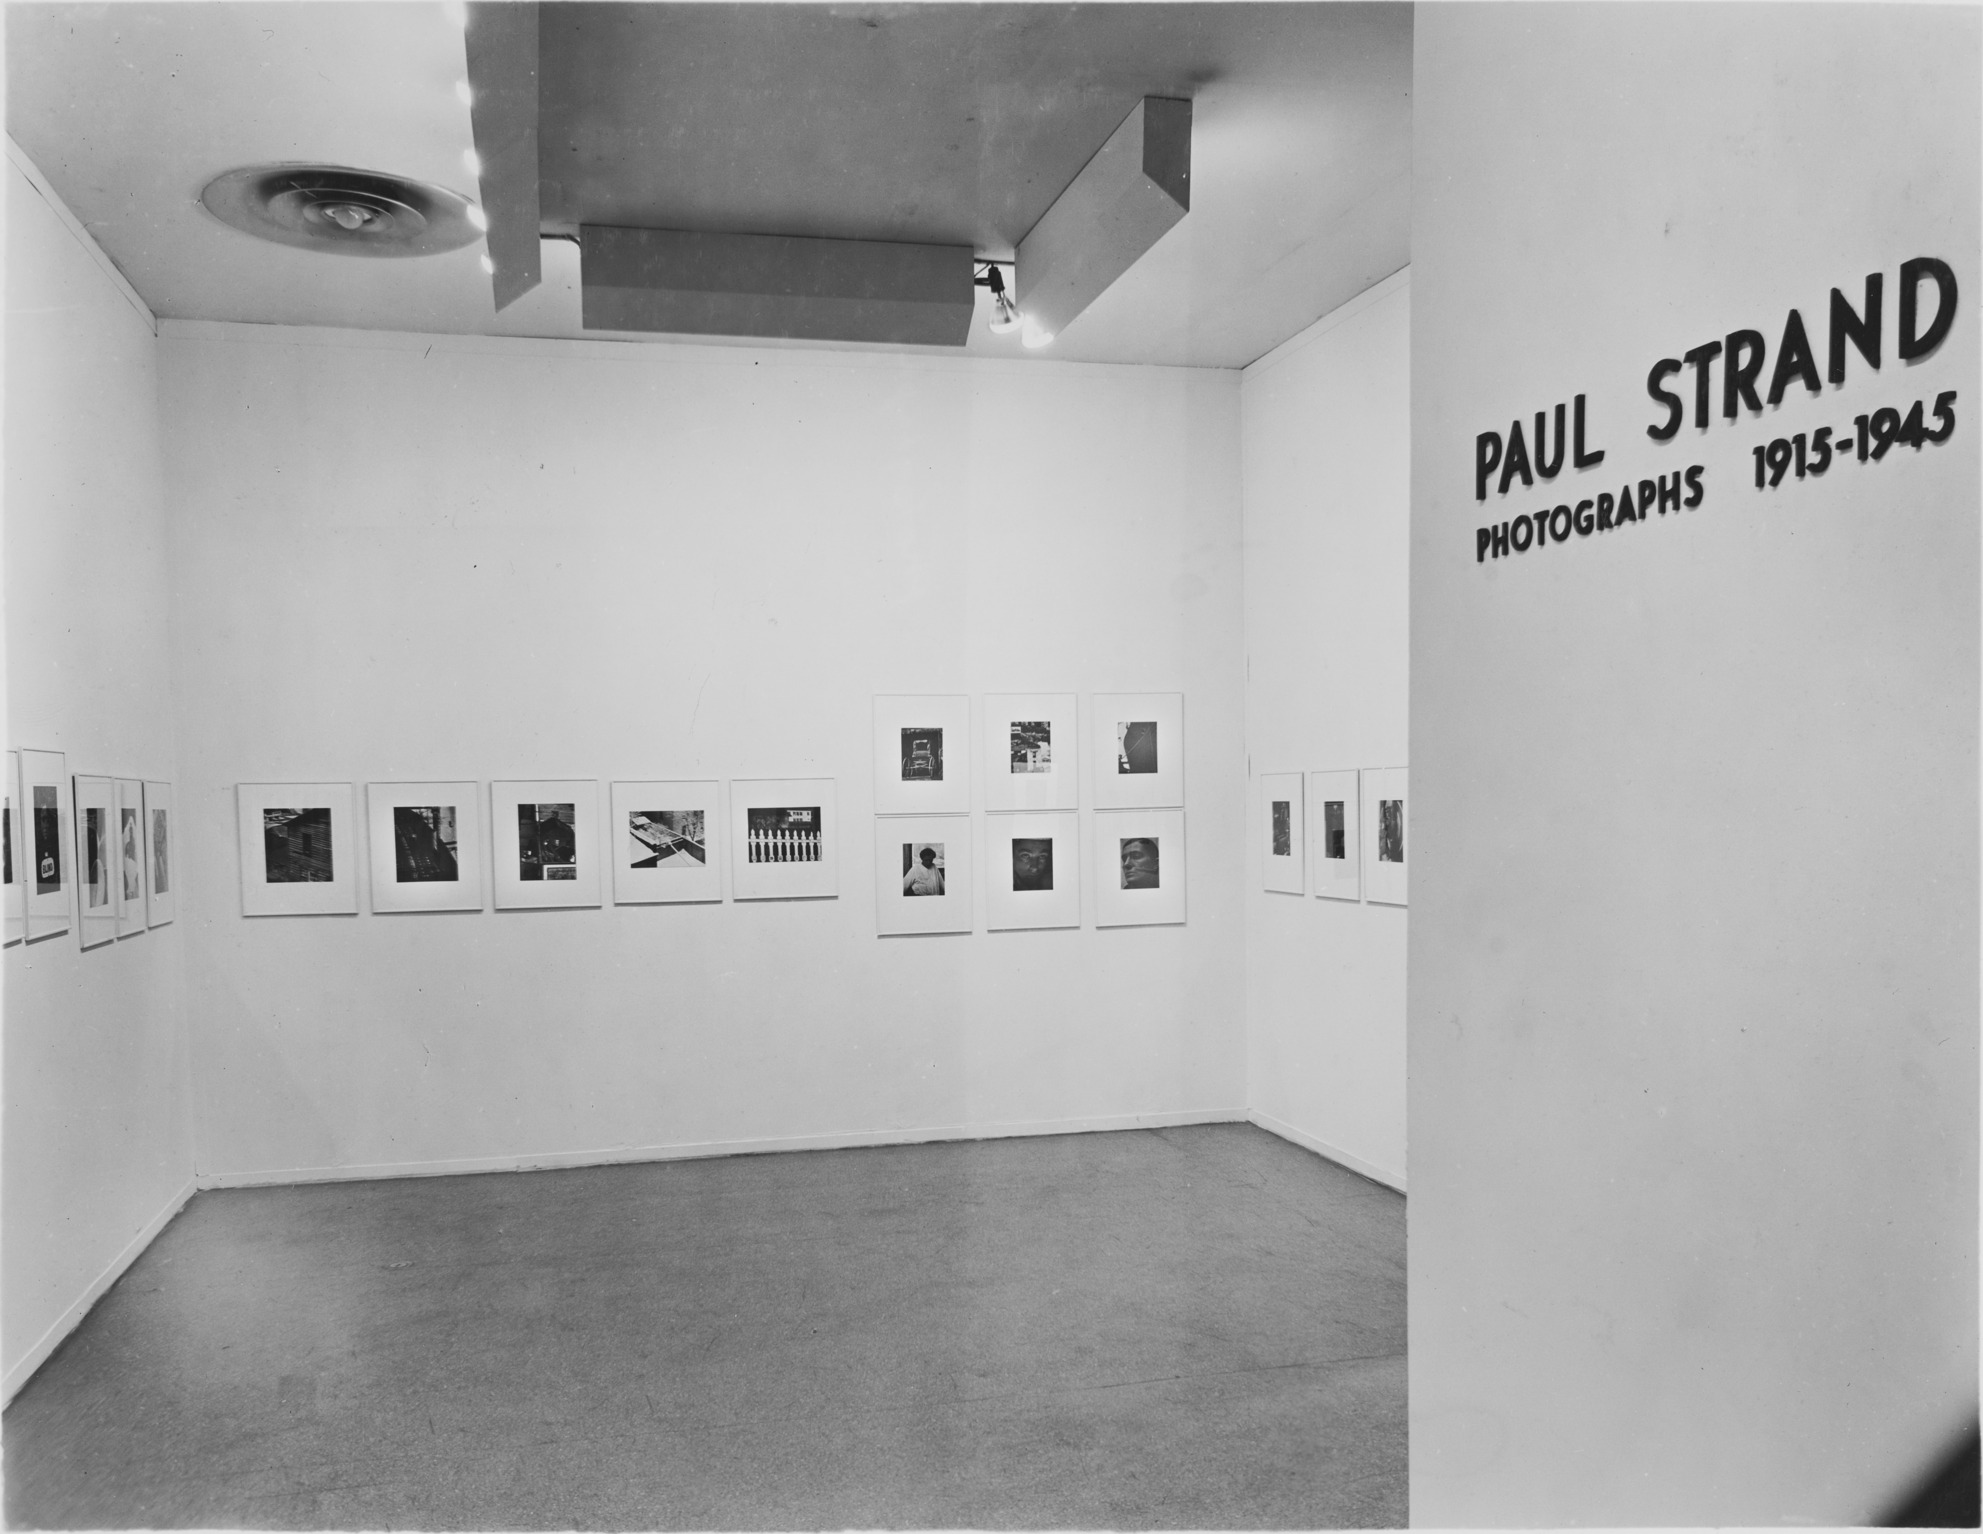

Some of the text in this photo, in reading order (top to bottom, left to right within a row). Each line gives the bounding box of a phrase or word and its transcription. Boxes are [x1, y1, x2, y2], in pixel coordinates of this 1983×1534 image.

[1476, 257, 1958, 501] PAUL STRAND
[1476, 390, 1957, 563] PHOTOGRAPHS 1915-1945
